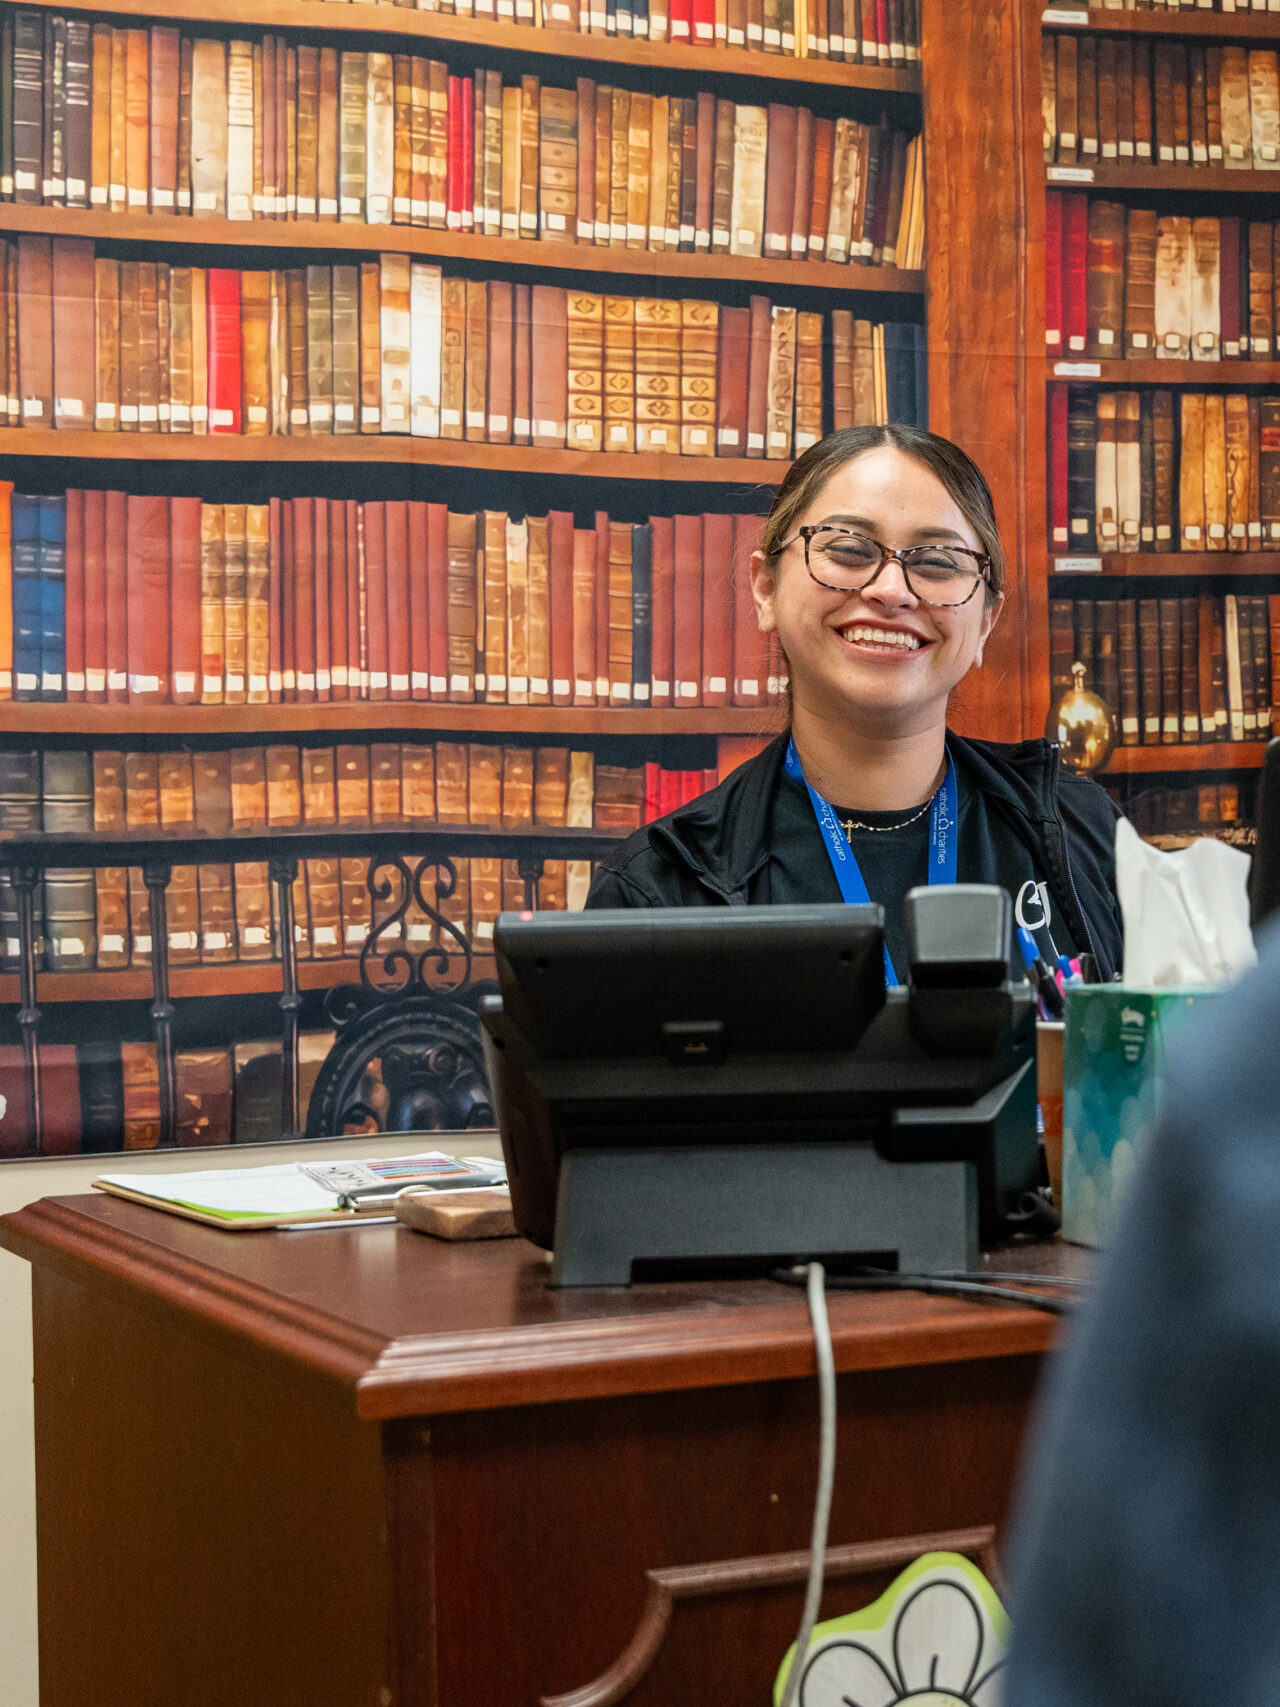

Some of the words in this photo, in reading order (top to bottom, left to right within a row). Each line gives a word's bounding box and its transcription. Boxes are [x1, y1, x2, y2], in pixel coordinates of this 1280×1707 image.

[938, 787, 949, 817] catholic
[829, 829, 847, 861] catholic
[937, 831, 949, 865] charities
